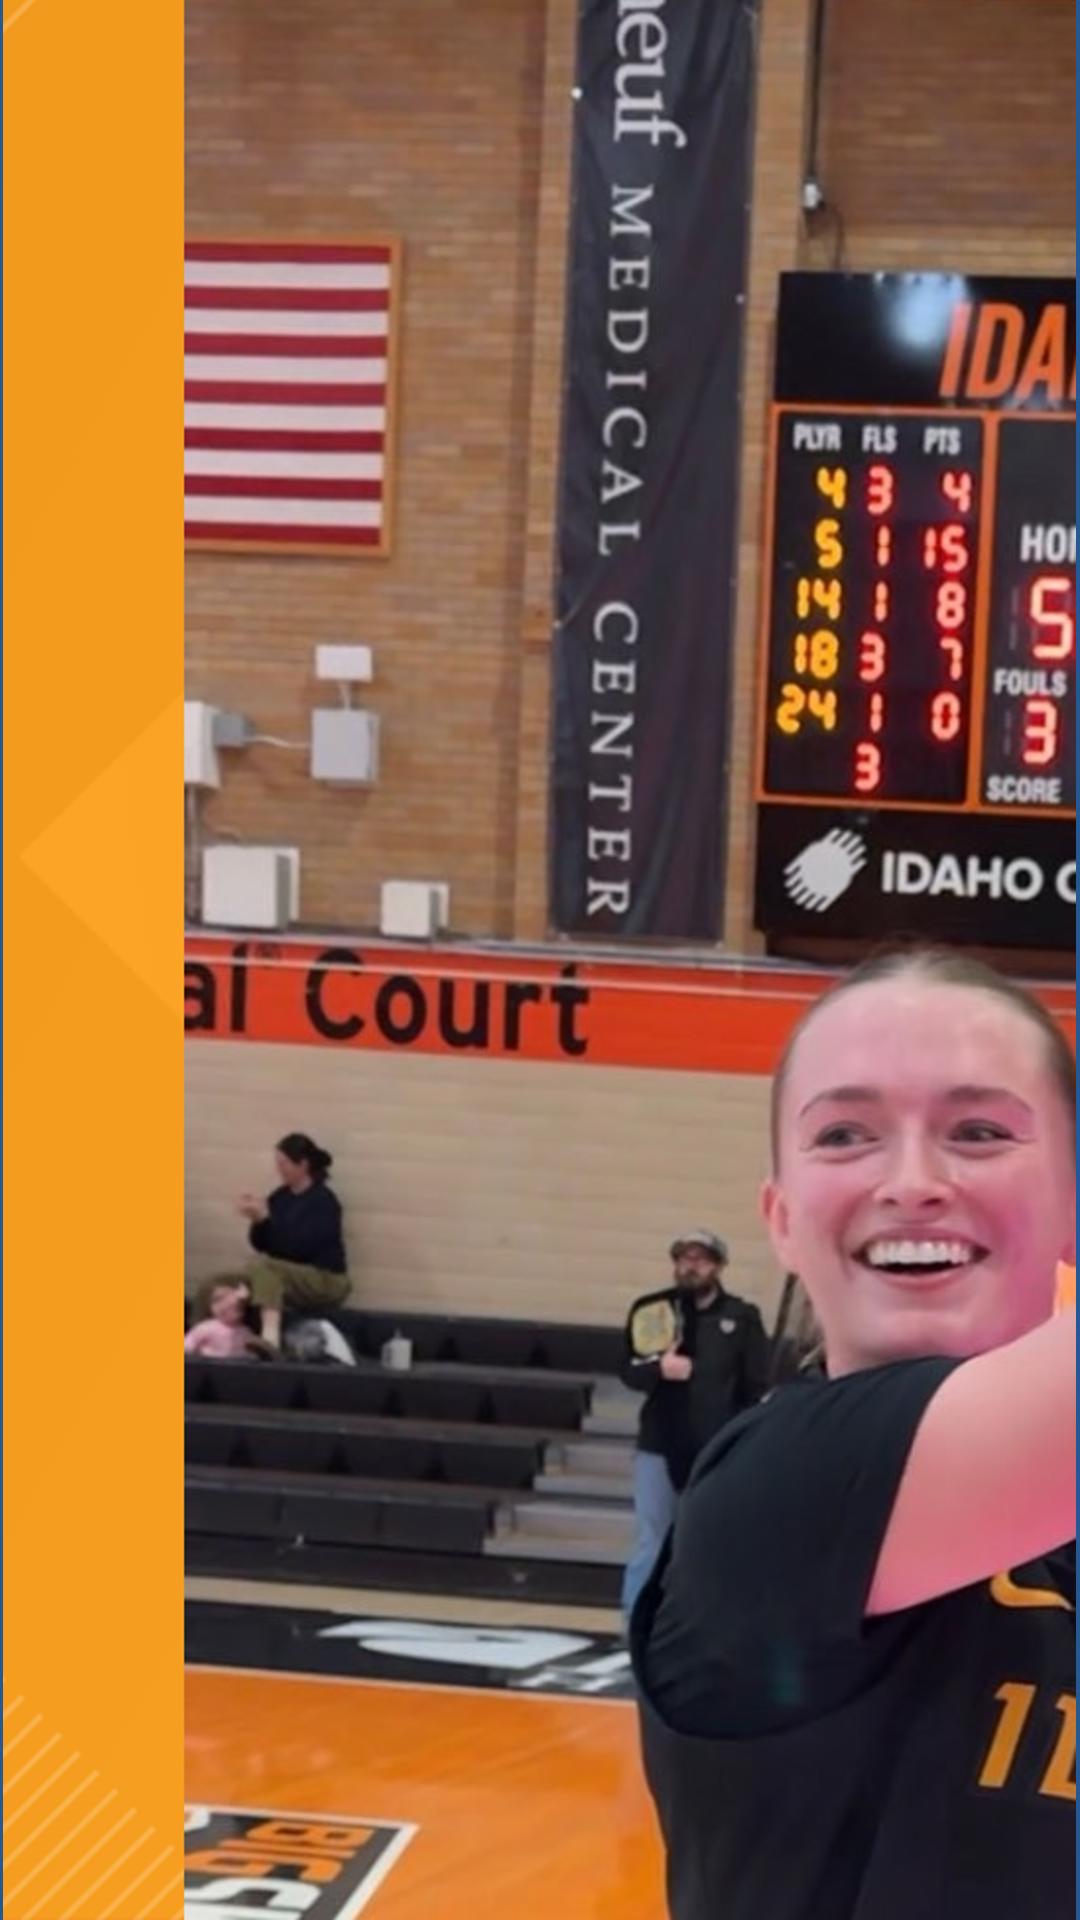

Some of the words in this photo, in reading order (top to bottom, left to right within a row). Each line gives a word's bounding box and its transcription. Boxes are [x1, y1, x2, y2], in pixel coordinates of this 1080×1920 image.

[598, 184, 654, 556] MEDICAL
[939, 302, 1076, 399] IDA
[793, 422, 842, 451] PLYR
[862, 425, 897, 453] FLS
[924, 427, 961, 455] PTS
[817, 467, 846, 509] 4
[867, 466, 893, 514] 3
[943, 472, 971, 512] 4
[815, 519, 842, 568] 5
[877, 527, 890, 566] 1
[924, 525, 968, 571] 15
[797, 578, 841, 619] 14
[876, 581, 888, 621] 1
[937, 582, 965, 628] 8
[795, 630, 839, 679] 18
[860, 632, 885, 682] 3
[940, 637, 963, 680] 7
[994, 669, 1067, 696] FOULS
[776, 684, 836, 733] 24
[871, 693, 882, 732] 1
[932, 692, 960, 740] 0
[1023, 701, 1057, 763] 3
[586, 602, 640, 915] CENTER
[855, 743, 880, 790] 3
[987, 776, 1062, 803] SCORE
[881, 850, 1044, 901] IDAHO
[305, 947, 590, 1056] Court
